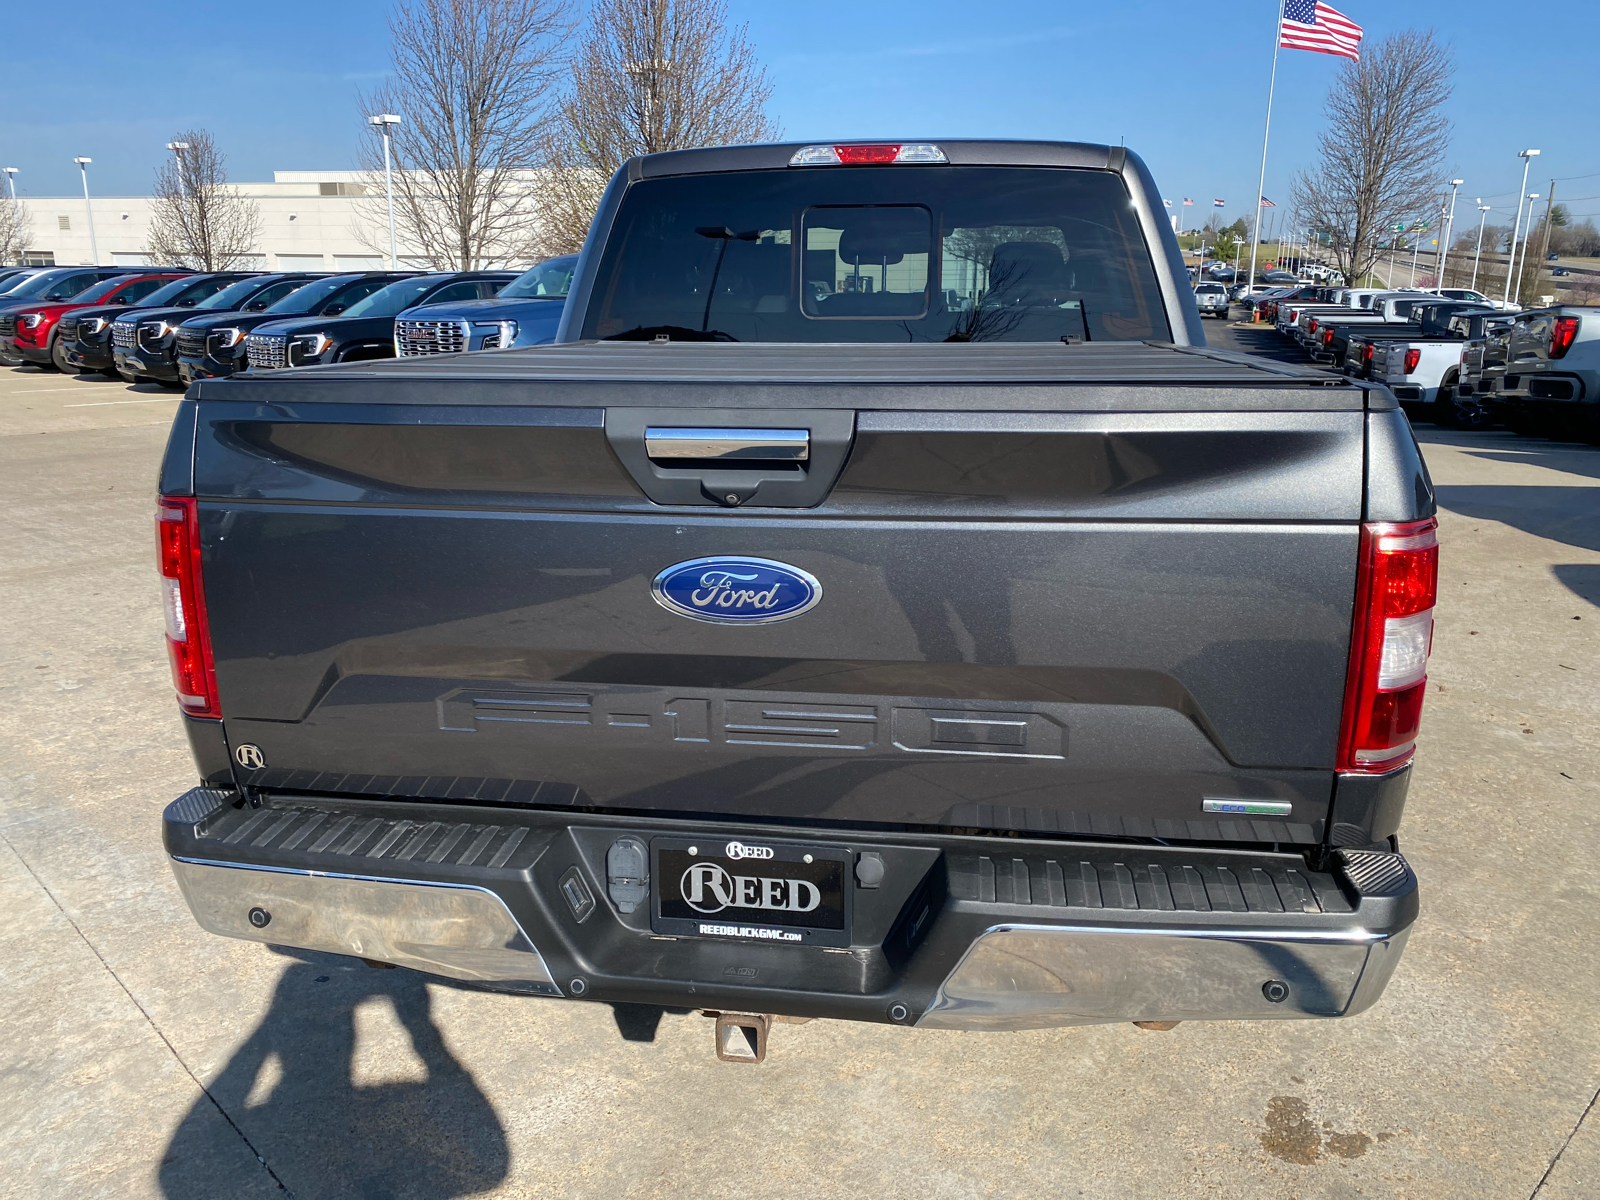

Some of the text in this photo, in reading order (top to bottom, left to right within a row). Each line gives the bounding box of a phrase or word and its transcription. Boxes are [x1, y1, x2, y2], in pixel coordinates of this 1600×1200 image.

[407, 328, 435, 339] GMC
[691, 571, 780, 610] Ford
[435, 687, 1070, 760] F-150
[725, 841, 774, 860] REED
[680, 862, 821, 914] REED
[699, 924, 802, 941] REEDBUICKGMC.COM
